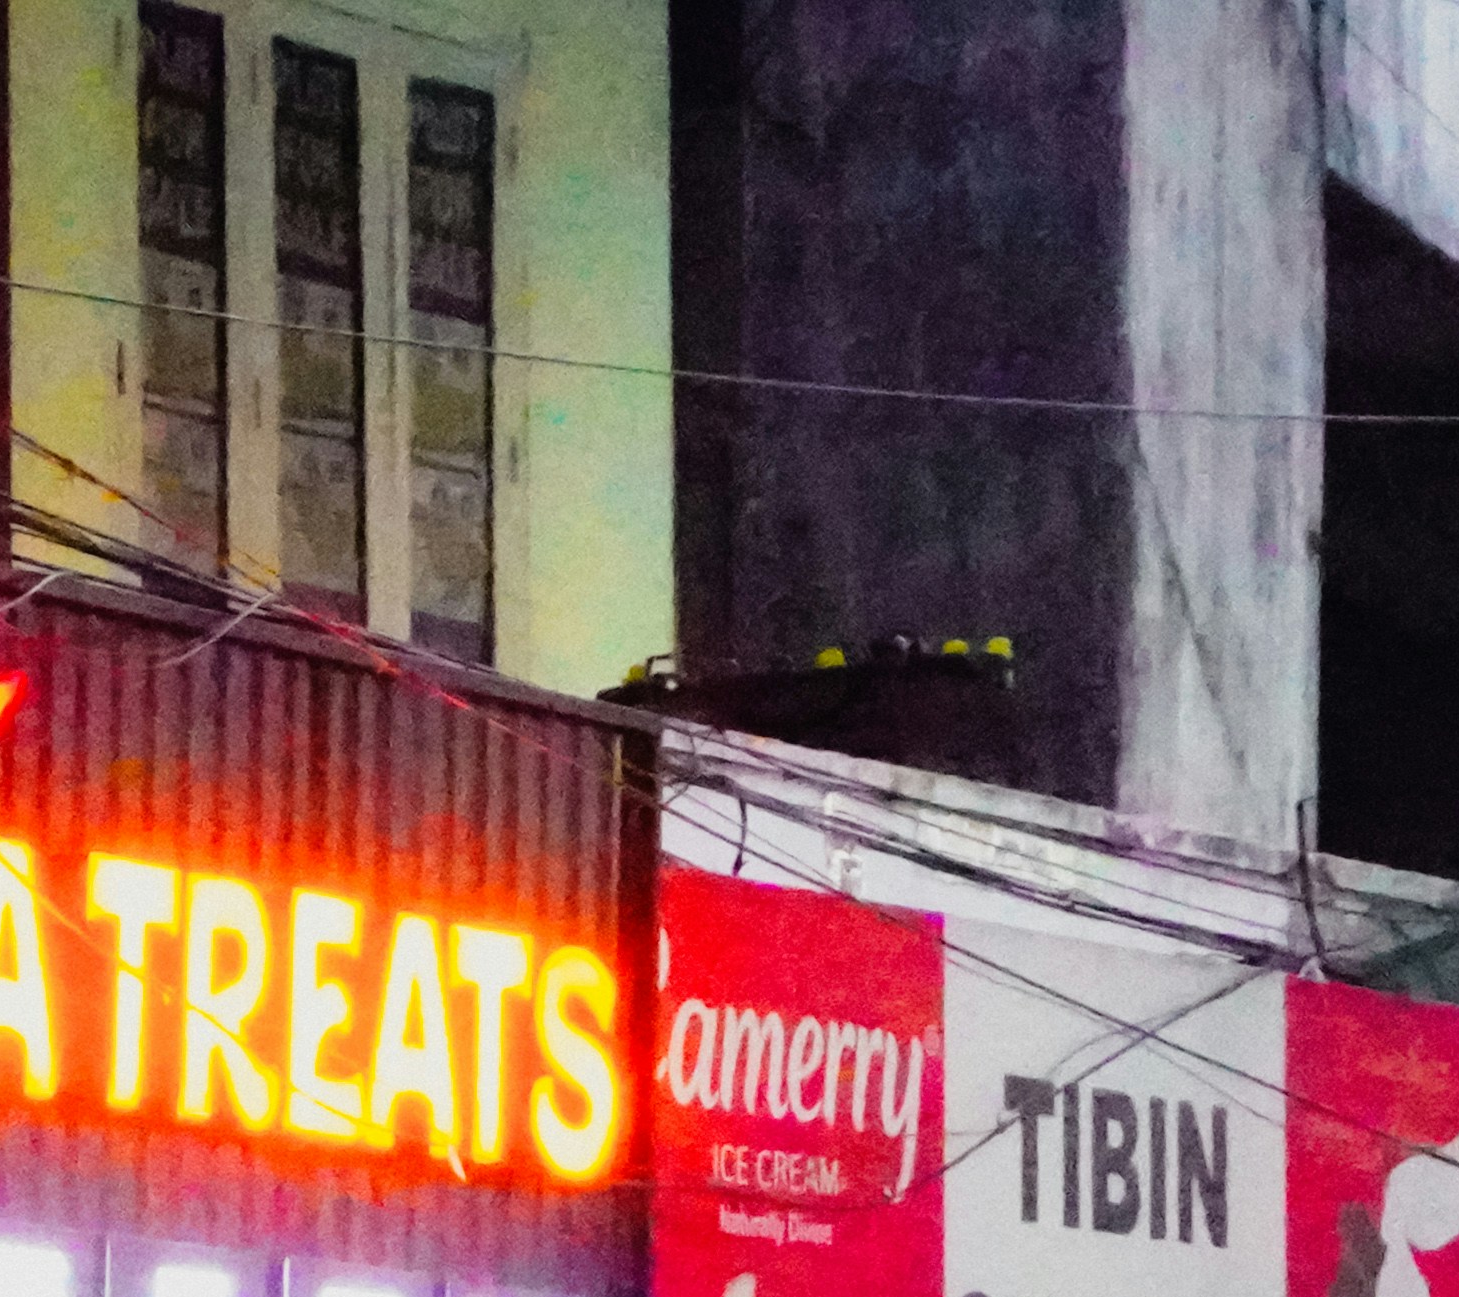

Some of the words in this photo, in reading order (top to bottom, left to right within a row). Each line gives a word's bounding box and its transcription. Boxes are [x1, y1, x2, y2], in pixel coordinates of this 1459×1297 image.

[80, 848, 620, 1183] TREATS
[654, 922, 923, 1204] amerry
[711, 1142, 750, 1187] ICE
[756, 1147, 842, 1197] CREAM
[1003, 1074, 1229, 1249] TIBIN
